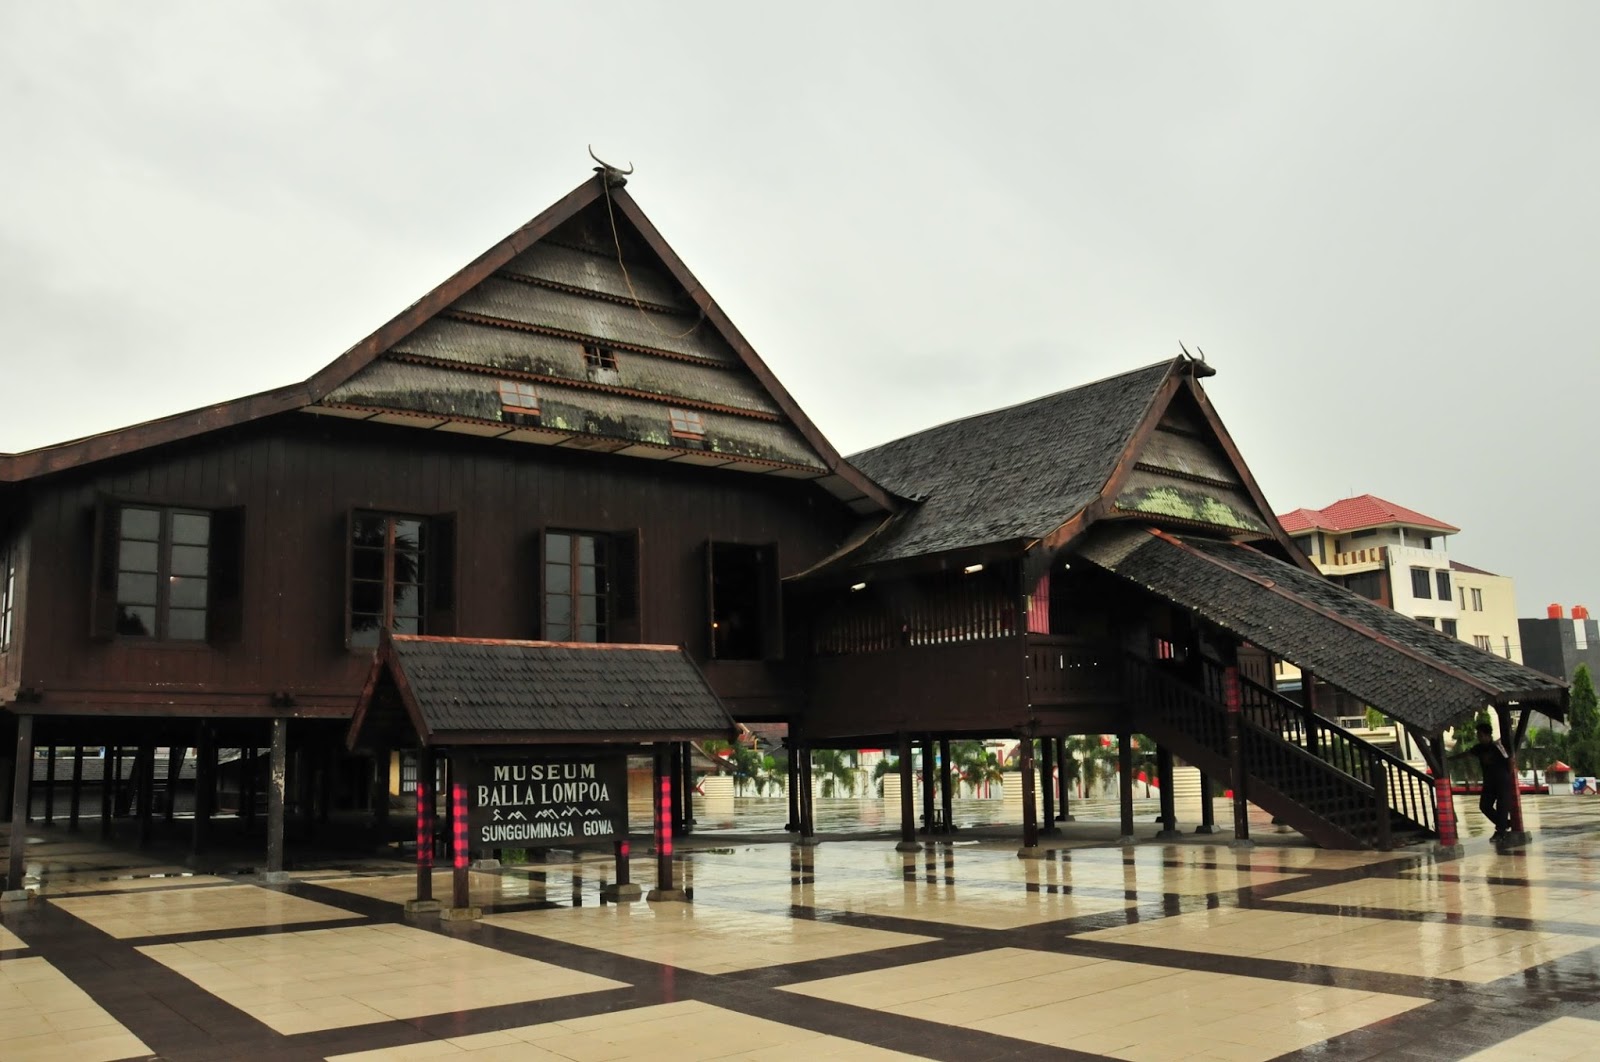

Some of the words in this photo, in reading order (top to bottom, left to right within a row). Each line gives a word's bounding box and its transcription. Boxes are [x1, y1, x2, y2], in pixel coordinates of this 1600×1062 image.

[493, 763, 596, 781] MUSEUM
[477, 785, 535, 807] BALLA
[541, 782, 610, 804] LOMPOA
[481, 822, 574, 842] SUNGGUMINASA
[583, 819, 614, 836] GOWA
